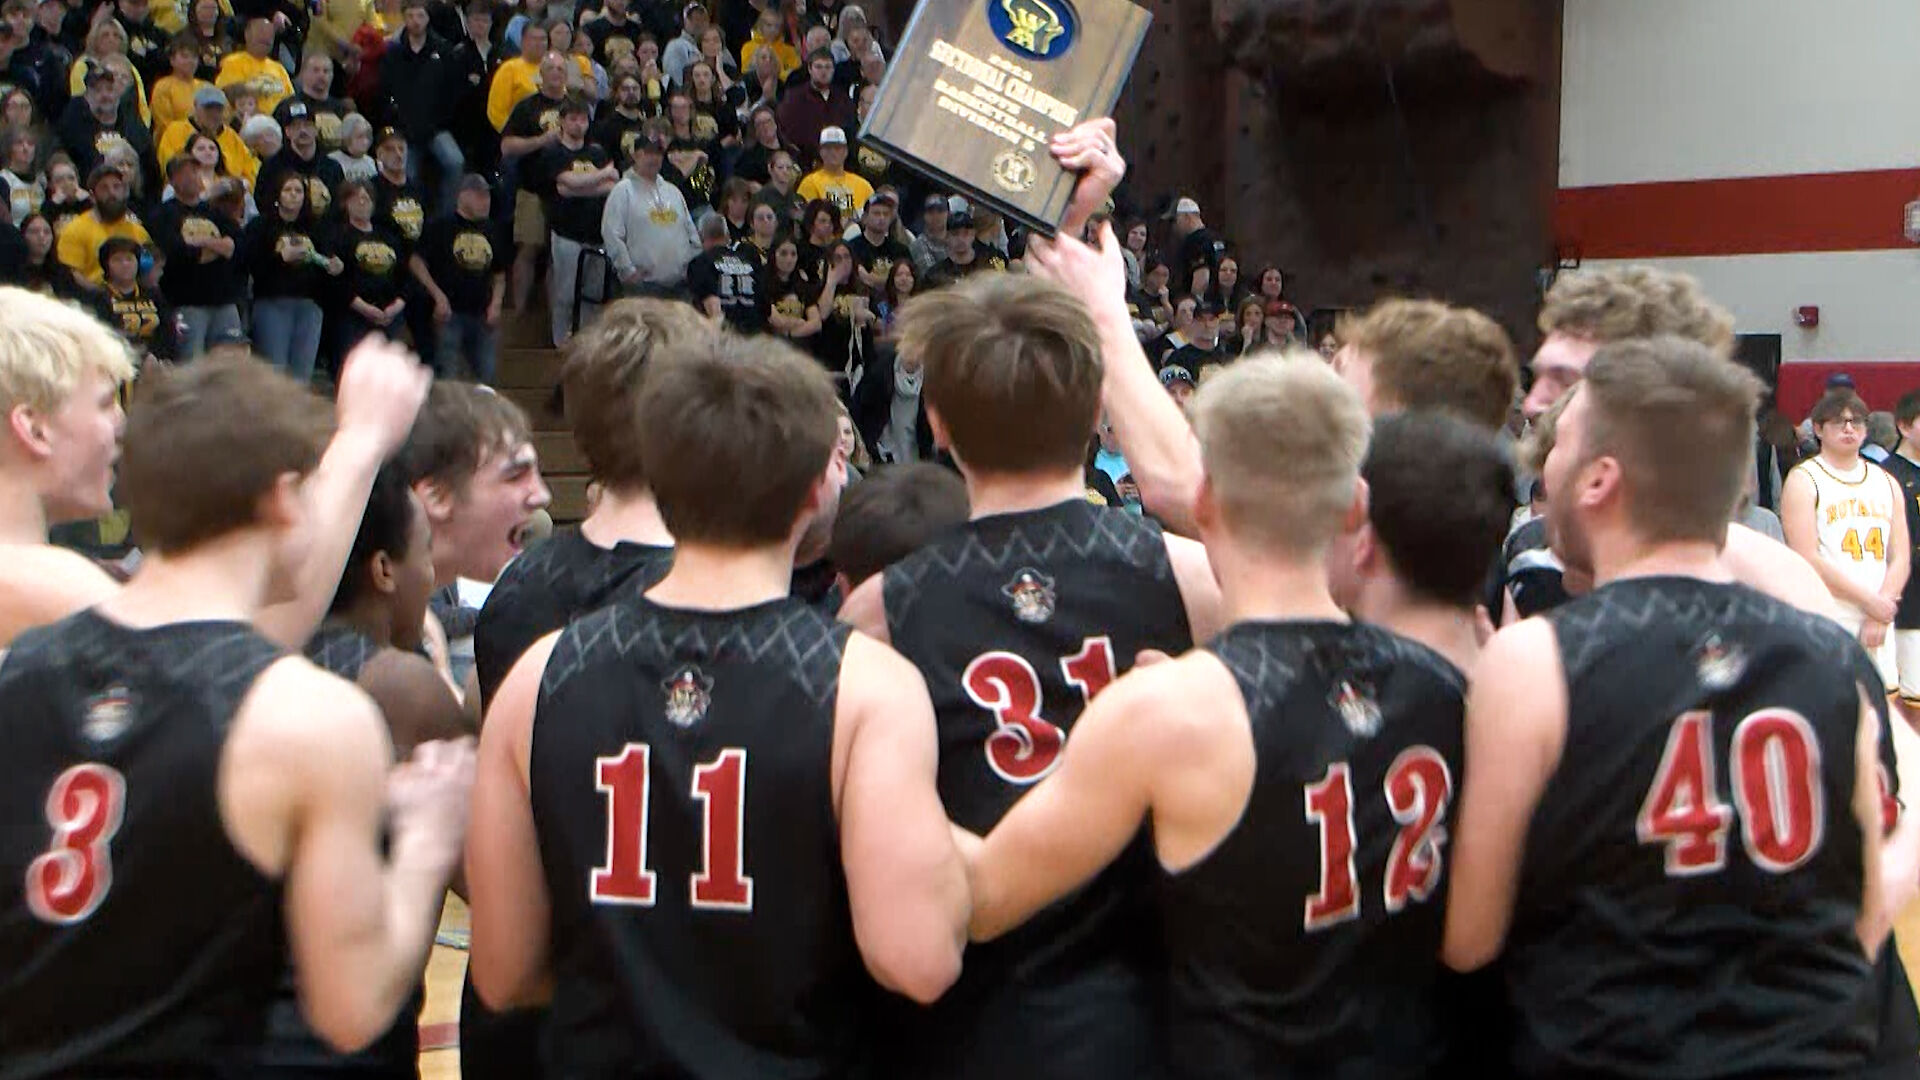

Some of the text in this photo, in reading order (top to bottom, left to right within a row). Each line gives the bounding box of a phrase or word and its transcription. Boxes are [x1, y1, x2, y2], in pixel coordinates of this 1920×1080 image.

[928, 38, 1007, 93] SECTIONAL
[1004, 77, 1079, 128] CHAMPIONS
[933, 78, 1048, 145] BASKETBALL
[937, 95, 1022, 145] DIVISION
[971, 83, 1022, 115] BOYS
[1841, 527, 1885, 561] 44
[589, 742, 753, 912] 11
[1635, 706, 1826, 877] 40
[25, 762, 127, 925] 3
[1304, 744, 1453, 932] 12
